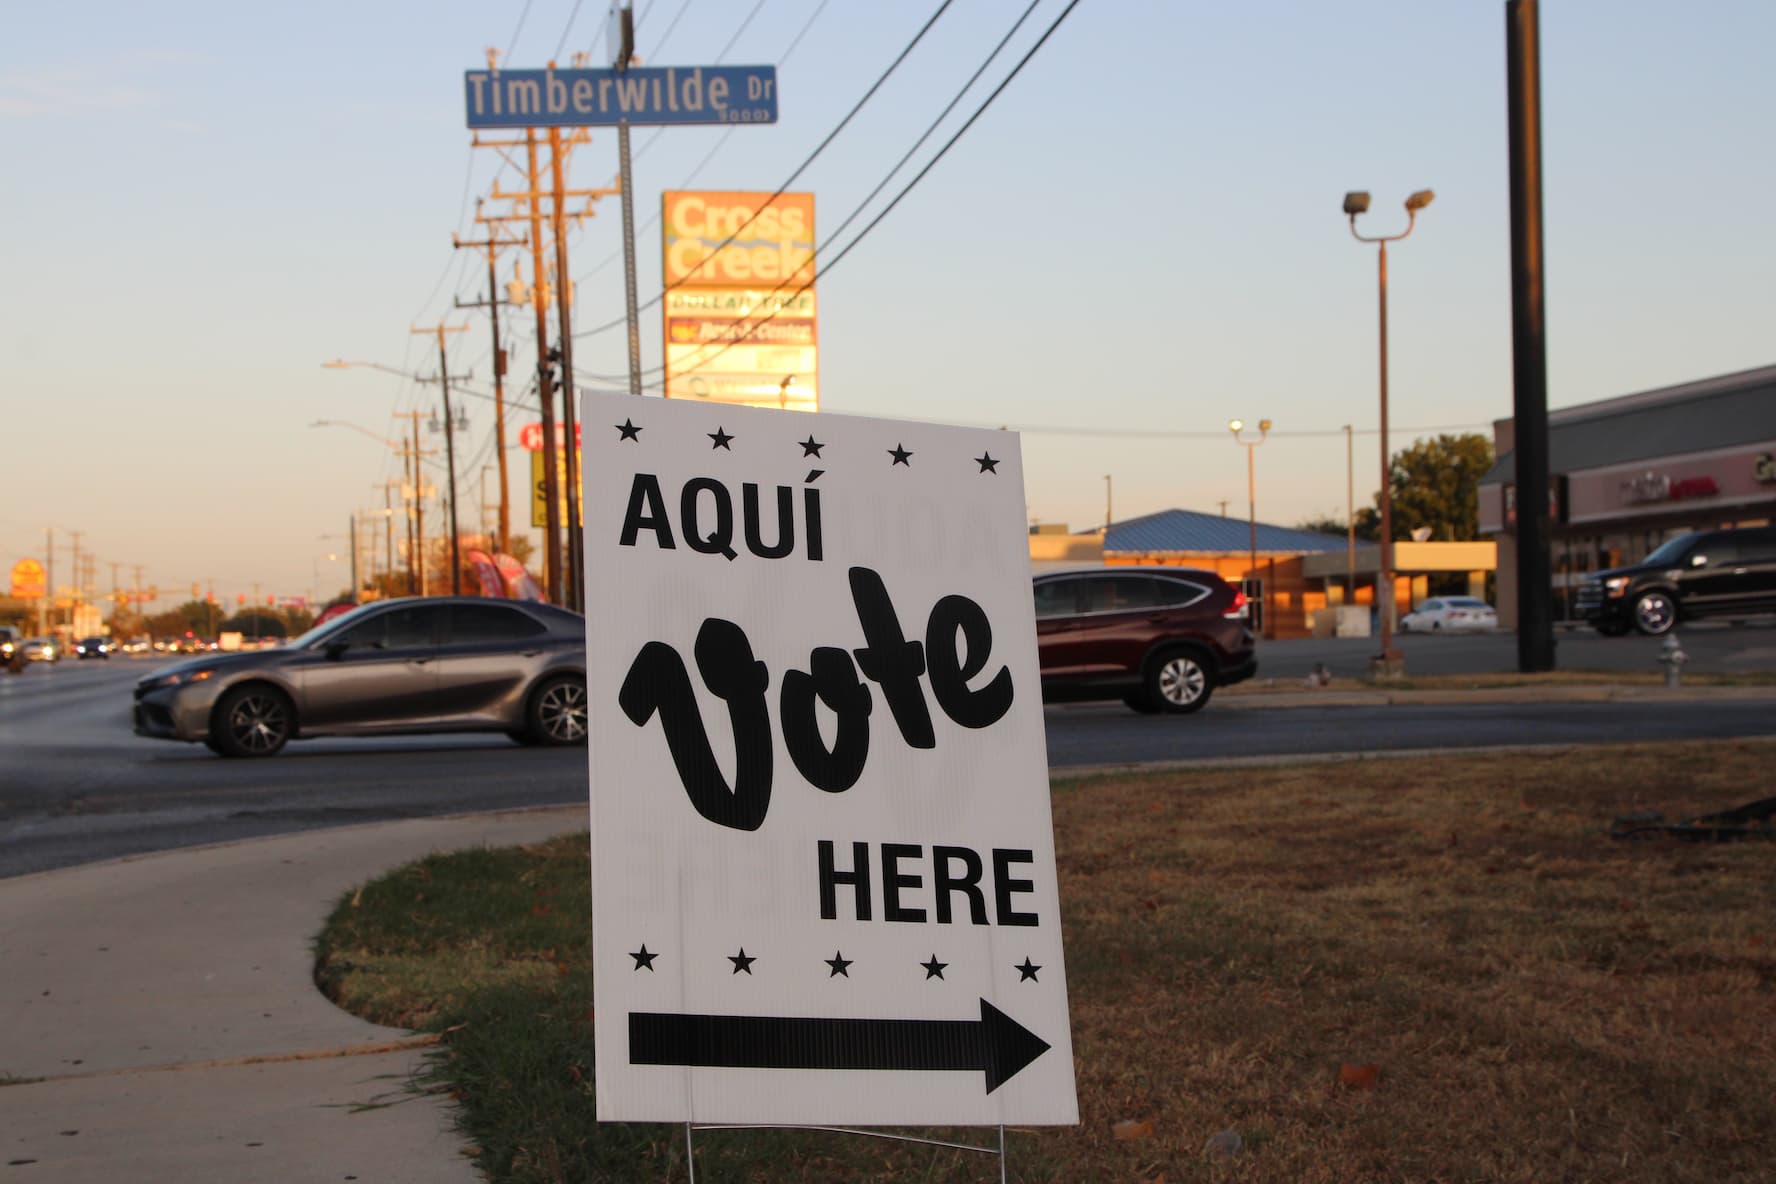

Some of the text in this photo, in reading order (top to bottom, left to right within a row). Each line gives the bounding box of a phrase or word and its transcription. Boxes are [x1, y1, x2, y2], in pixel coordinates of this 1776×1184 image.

[468, 67, 772, 115] Timberwilde Dr
[672, 196, 805, 240] Cross
[669, 238, 811, 280] Creek
[619, 469, 826, 562] AQUÍ
[618, 566, 1014, 832] Vote
[817, 840, 1039, 927] HERE
